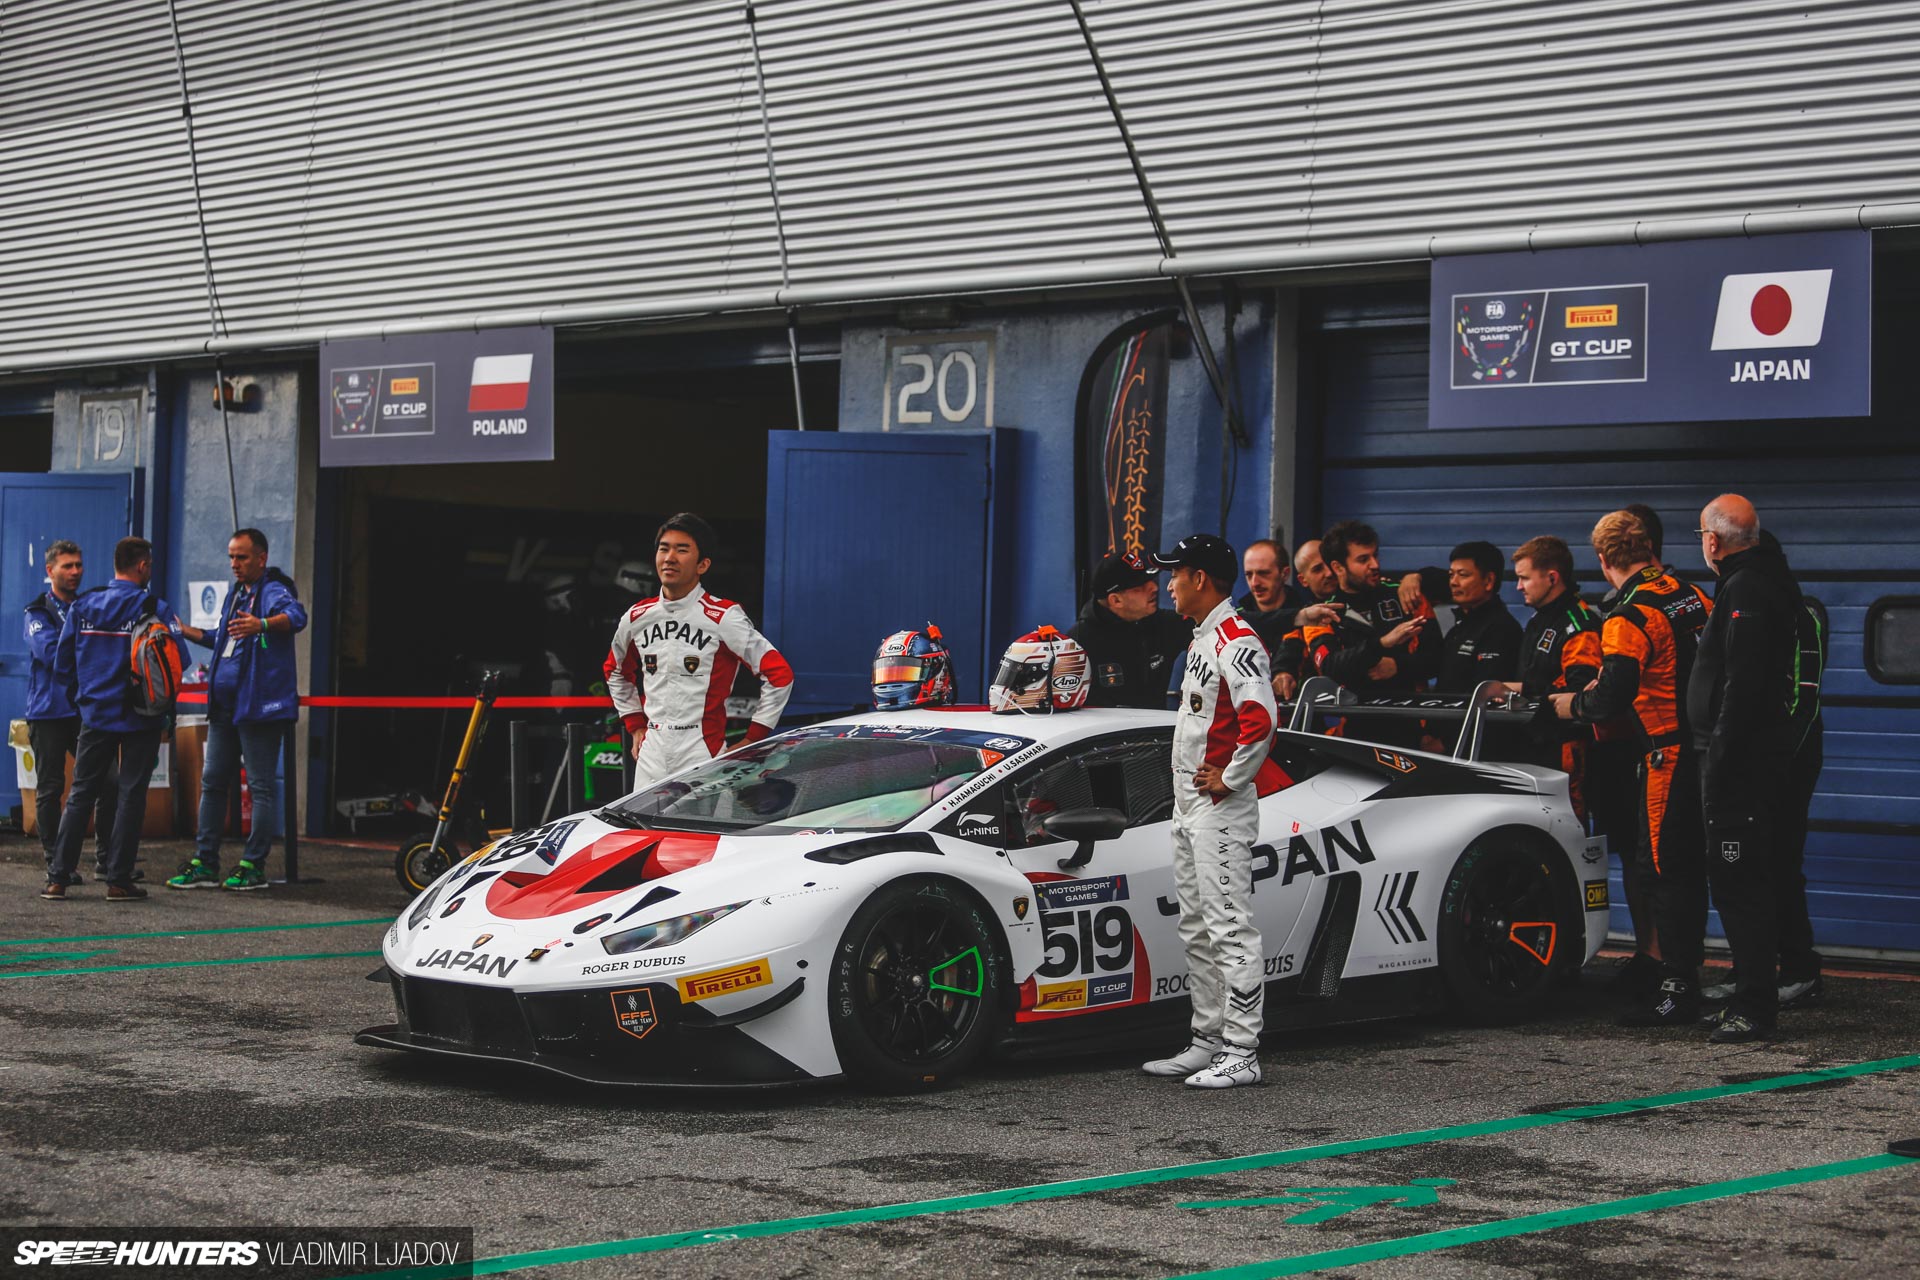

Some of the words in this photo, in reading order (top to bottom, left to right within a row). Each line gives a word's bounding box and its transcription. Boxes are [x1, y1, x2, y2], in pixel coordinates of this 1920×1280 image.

[1485, 302, 1505, 318] FIA
[1570, 308, 1613, 324] PIRELLI
[1466, 325, 1523, 334] MOTORSPORT
[1479, 334, 1510, 342] GAMES
[1550, 341, 1581, 357] GT
[1585, 339, 1632, 355] CUP
[1730, 359, 1811, 383] JAPAN
[898, 350, 977, 424] 20
[383, 404, 400, 416] GT
[401, 402, 427, 415] CUP
[94, 405, 125, 462] 19
[473, 418, 527, 436] POLAND
[641, 620, 713, 651] JAPAN
[1058, 674, 1079, 687] Arai
[948, 773, 997, 808] H.HAMAGUCHI
[1003, 743, 1049, 771] U.SASAHARA
[959, 826, 1000, 837] LI-NING
[1048, 881, 1111, 895] MOTORSPORT
[1218, 826, 1247, 966] MAGARIGAWA
[1065, 892, 1099, 902] GAMES
[1035, 905, 1134, 979] 519
[415, 948, 519, 979] JAPAN
[581, 961, 629, 975] ROGER
[633, 956, 687, 969] DUBUIS
[1378, 957, 1433, 969] MAGARIGAWA
[686, 965, 763, 998] PIRELLI
[1093, 985, 1107, 994] GT
[1107, 982, 1127, 991] CUP
[1043, 988, 1083, 1003] PIRELLI
[620, 1010, 650, 1020] FFF
[622, 1018, 639, 1026] RACING
